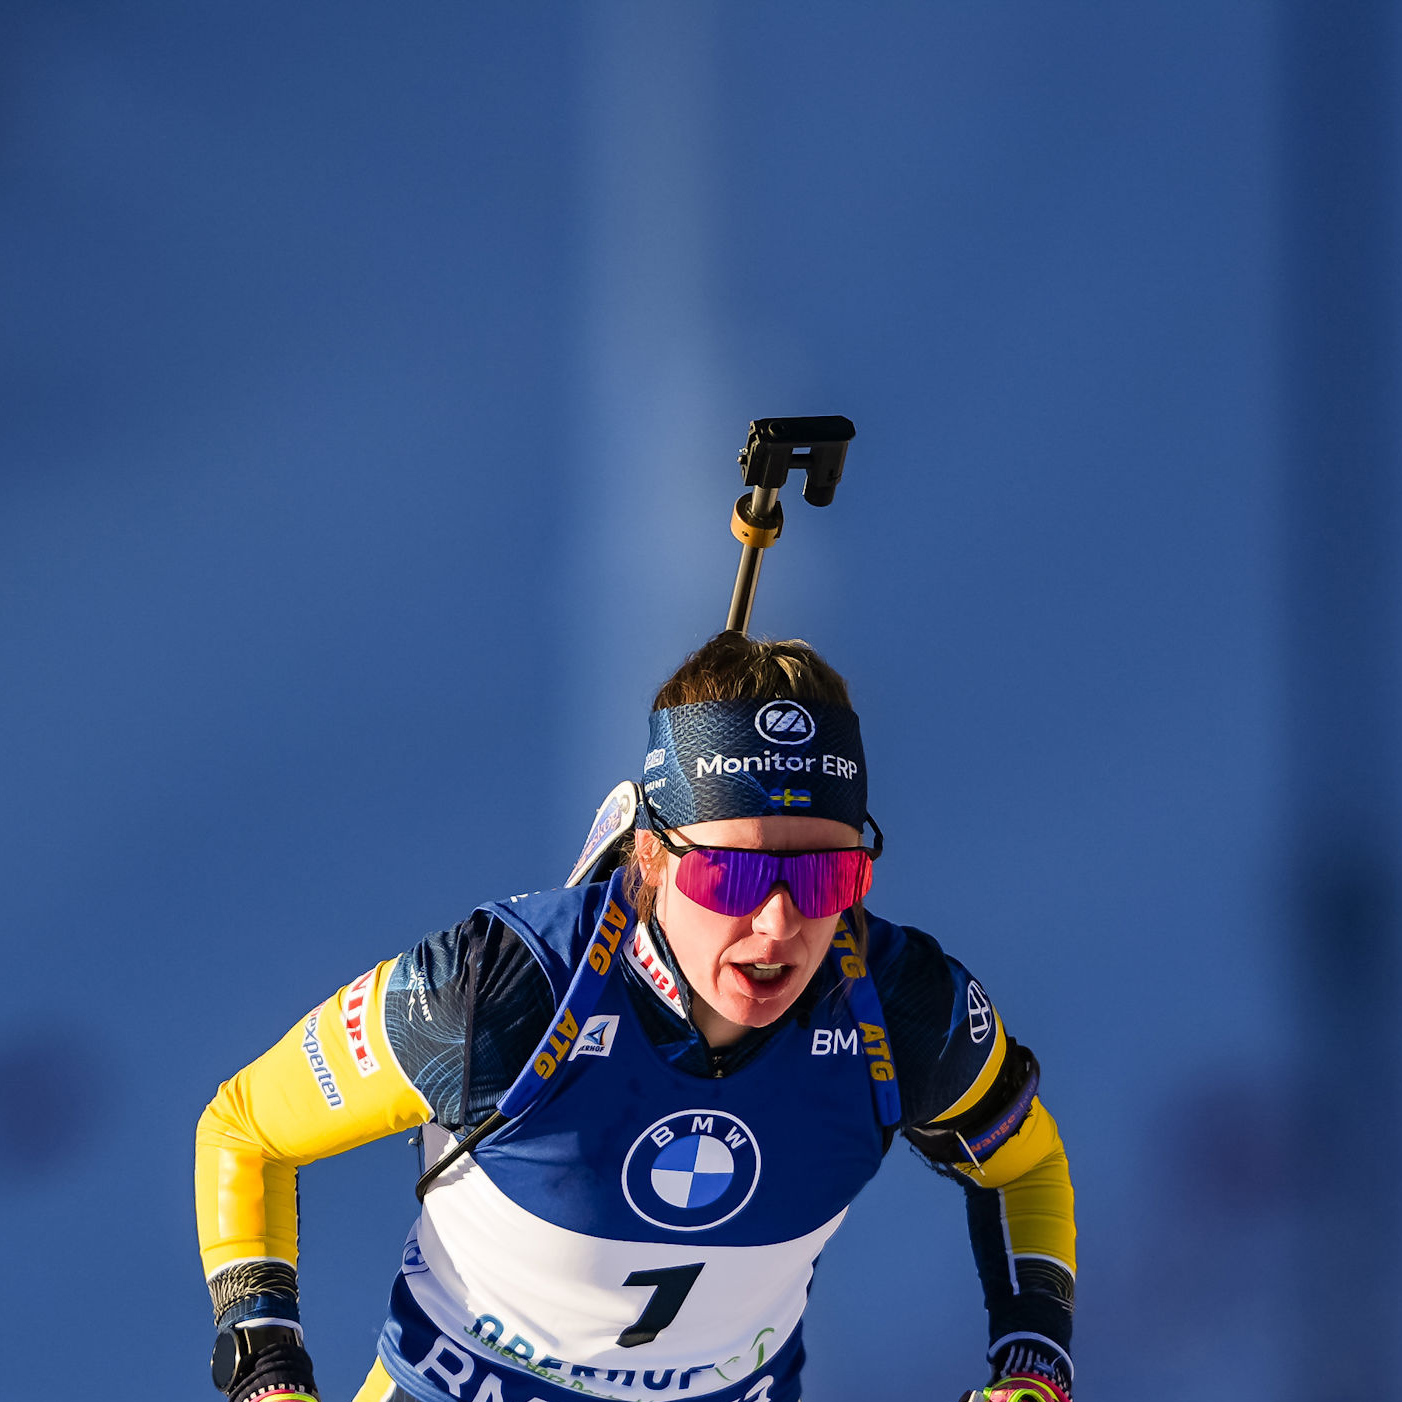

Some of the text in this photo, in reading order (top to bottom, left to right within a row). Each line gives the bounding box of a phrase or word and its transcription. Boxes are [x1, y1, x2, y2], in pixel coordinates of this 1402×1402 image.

[696, 750, 816, 780] Monitor
[822, 754, 858, 780] ERP
[588, 900, 628, 976] ATG
[533, 1008, 580, 1080] ATG
[811, 1028, 864, 1056] BM
[858, 1021, 895, 1082] ATG
[650, 1116, 748, 1150] BMW
